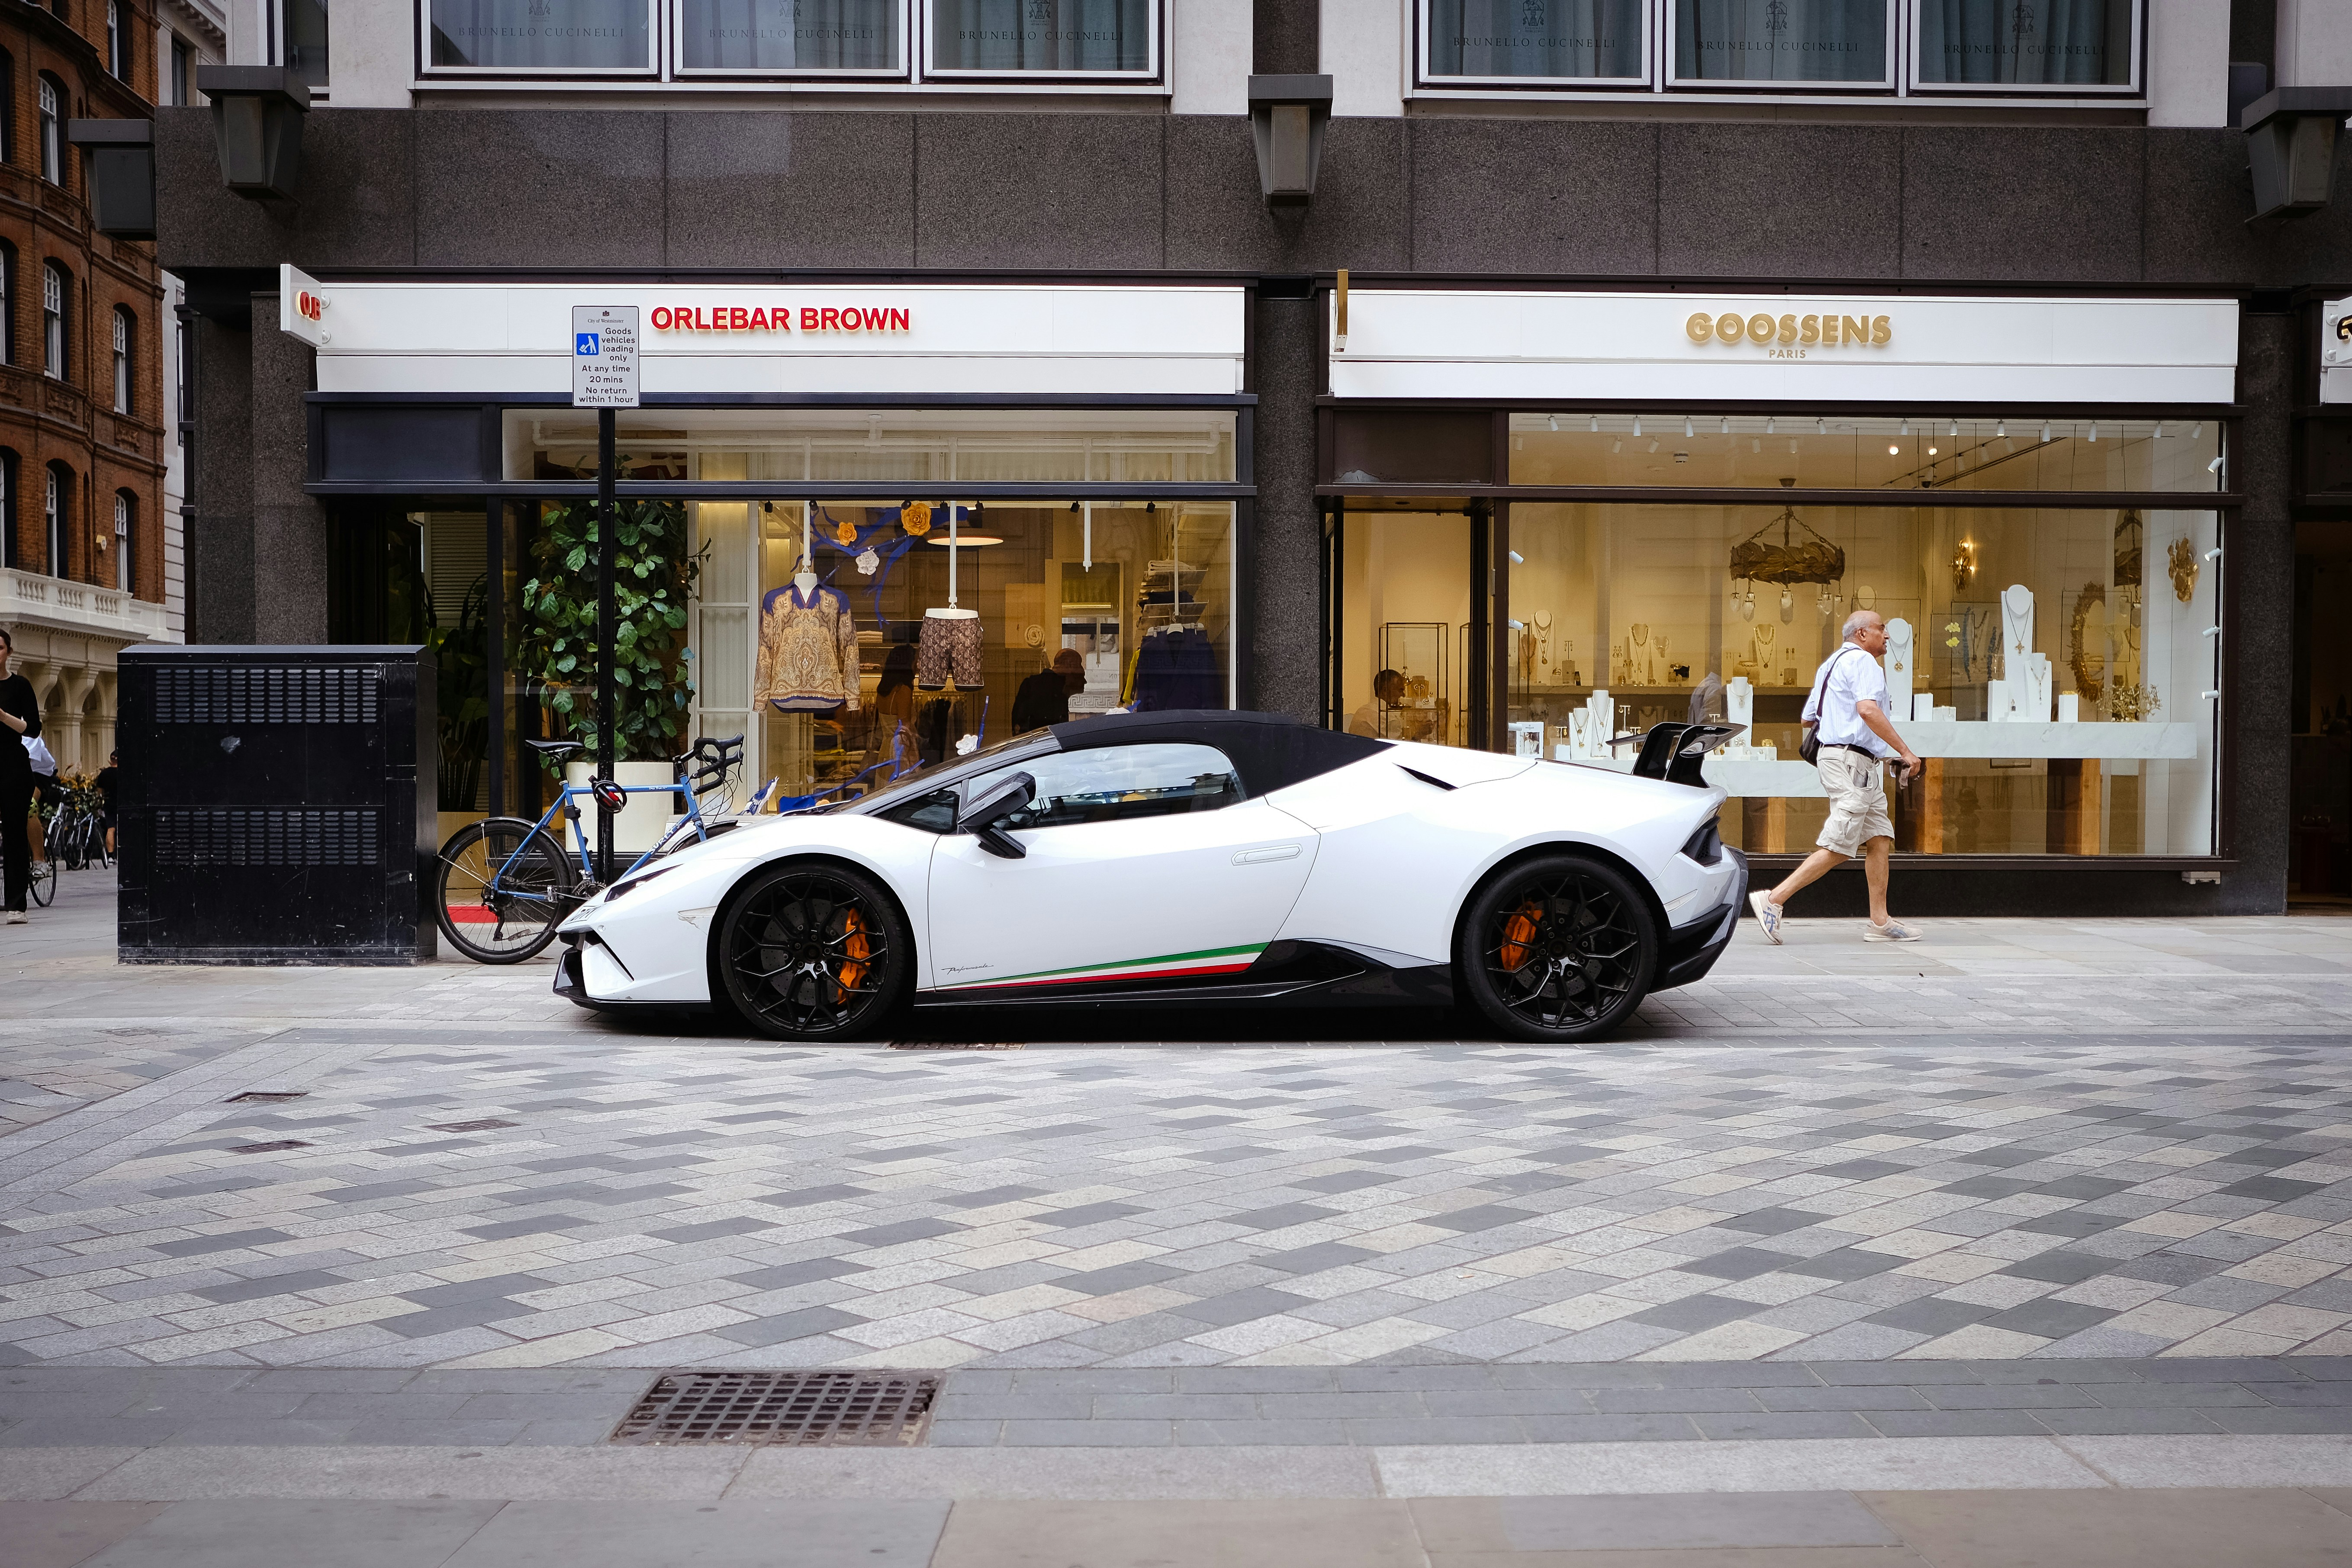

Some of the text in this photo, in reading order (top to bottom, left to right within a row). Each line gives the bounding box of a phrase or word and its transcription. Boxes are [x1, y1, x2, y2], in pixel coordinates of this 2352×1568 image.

[459, 27, 624, 37] BRUNELLO CUCINELLI
[710, 29, 873, 39] BRUNELLO CUCINELLI
[959, 31, 1123, 41] BRUNELLO CUCINELLI
[1454, 37, 1615, 48] BRUNELLO CUCINELLI
[1697, 41, 1858, 52] BRUNELLO CUCINELLI
[1944, 45, 2104, 55] BRUNELLO CUCINELLI
[651, 307, 909, 331] ORLEBAR BROWN
[1686, 312, 1892, 344] GOOSSENS
[1769, 349, 1806, 358] PARIS
[648, 828, 674, 855] SURLY
[941, 963, 994, 975] Performante
